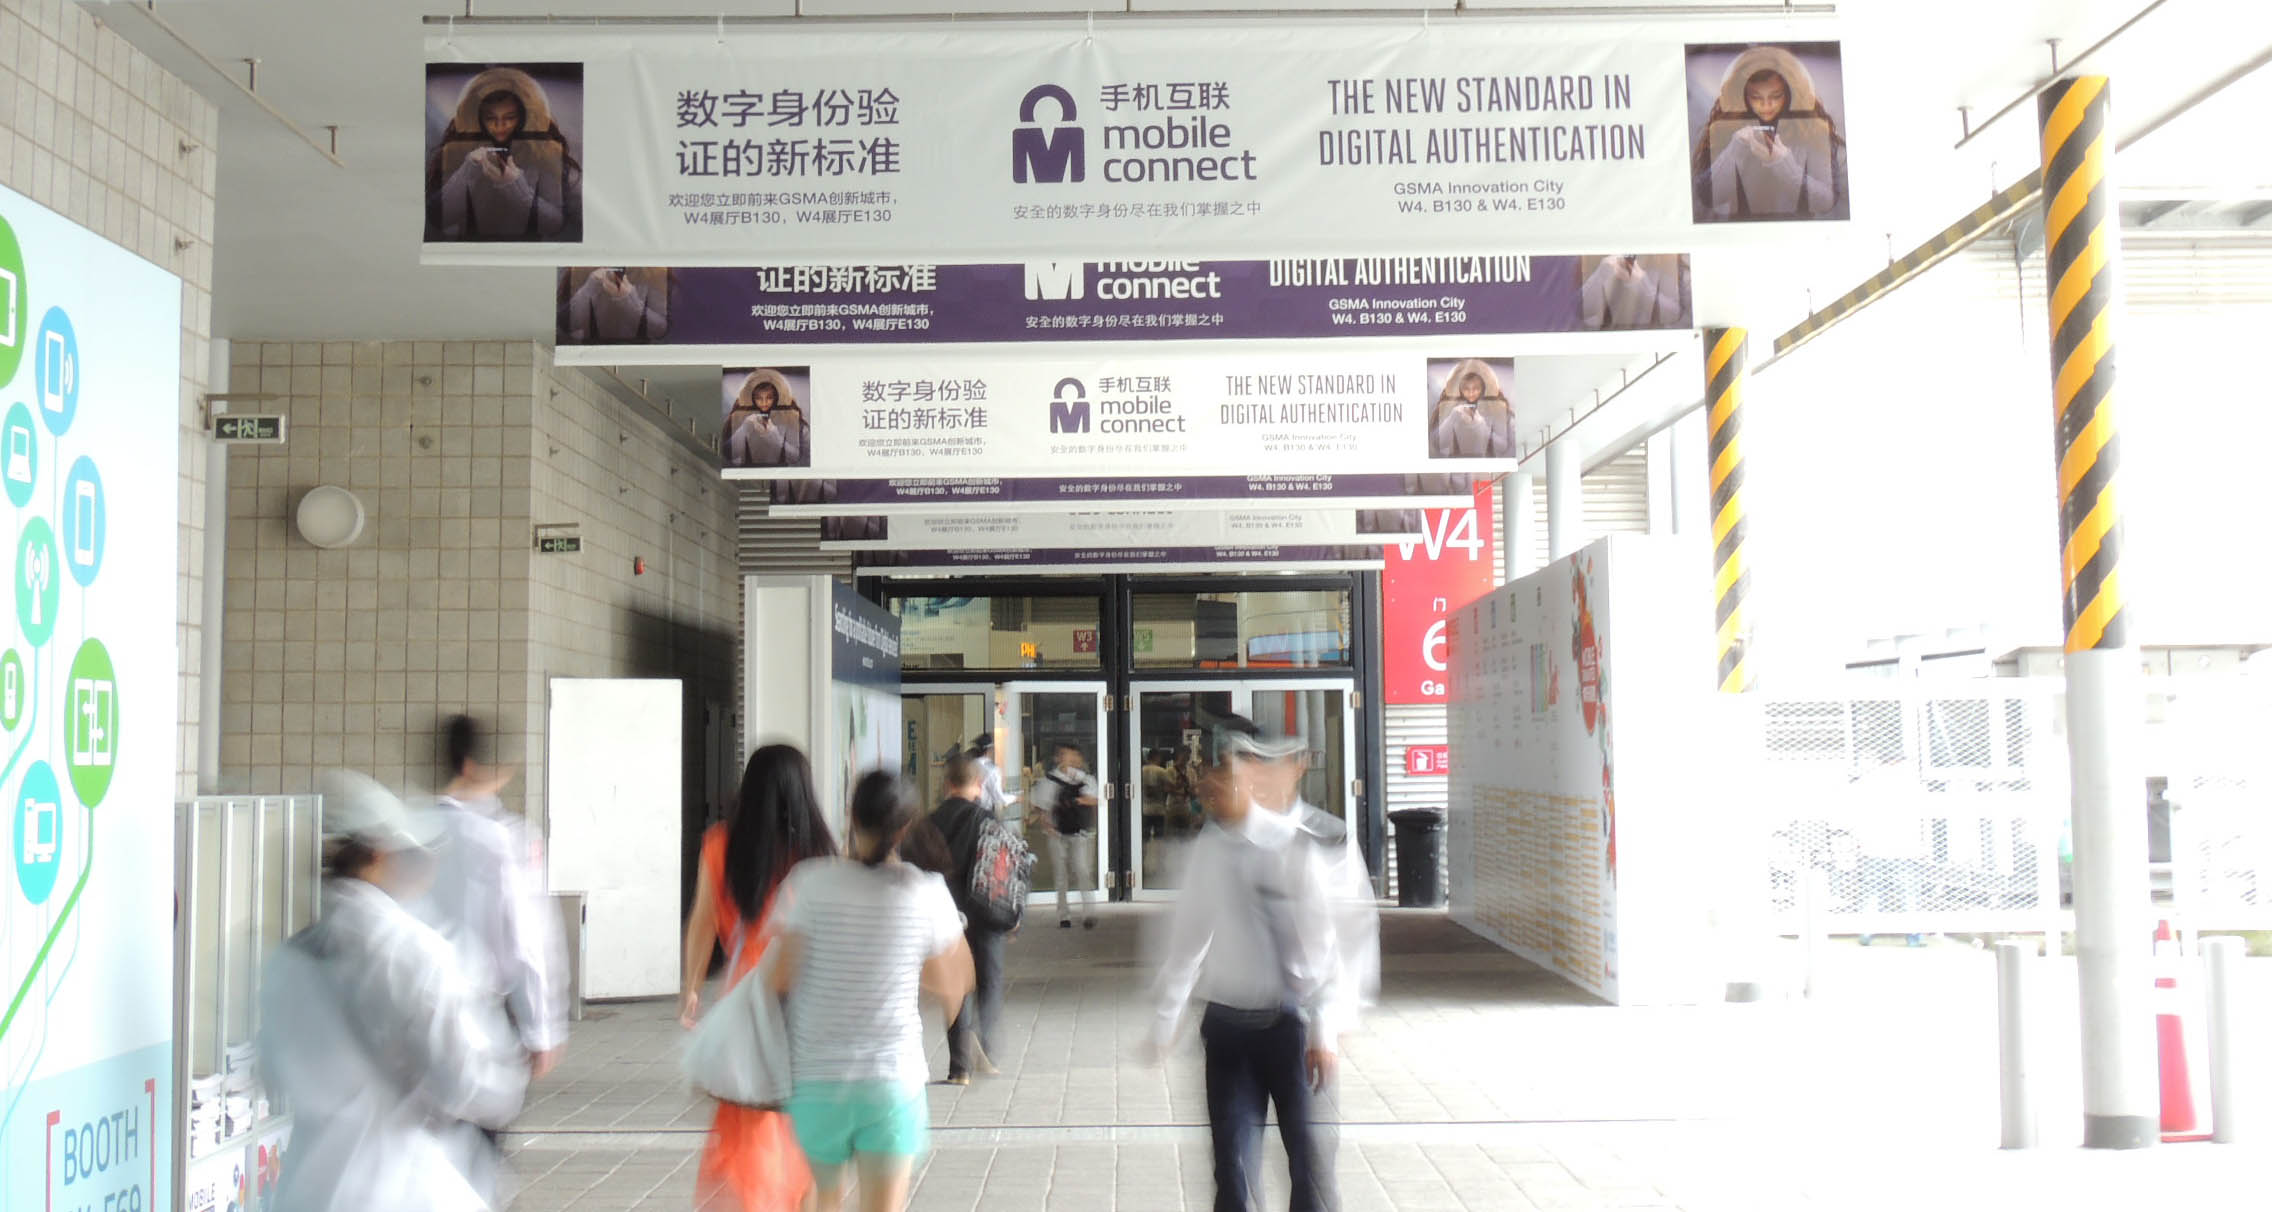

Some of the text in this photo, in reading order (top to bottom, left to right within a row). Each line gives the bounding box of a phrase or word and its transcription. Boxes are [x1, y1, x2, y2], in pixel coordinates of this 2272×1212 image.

[1100, 81, 1230, 111] 手机互联
[1327, 74, 1631, 115] THE NEW STANDARD IN
[676, 88, 900, 127] 数字身份验
[1104, 116, 1231, 149] mobile
[1319, 124, 1645, 165] DIGITAL AUTHENTICATION
[676, 137, 900, 177] 证的新标准
[1104, 150, 1257, 182] connect
[1394, 179, 1564, 195] GSMA Innovation City
[1013, 200, 1262, 219] 安全的数字身份尽在我们掌握之中
[1398, 197, 1566, 213] W4. B130 & W4. E130
[757, 264, 937, 293] 证的新标准
[1269, 255, 1531, 286] DIGITAL AUTHENTICATION
[1097, 272, 1221, 299] connect
[1329, 296, 1465, 310] GSMA Innovation City
[1026, 313, 1224, 328] 安全的数字身份尽在我们掌握之中
[1360, 312, 1392, 324] B130
[1395, 312, 1404, 323] &
[1435, 311, 1466, 323] E130
[862, 379, 987, 402] 数字身份验
[1099, 376, 1171, 393] 手机互联
[1225, 373, 1396, 396] THE NEW STANDARD IN
[1100, 395, 1171, 415] mobile
[1220, 402, 1403, 424] DIGITAL AUTHENTICATION
[862, 407, 988, 430] 证的新标准
[1100, 415, 1186, 433] connect
[1399, 509, 1485, 561] W4
[1077, 631, 1092, 641] W3
[1421, 680, 1446, 695] Ga
[64, 1105, 138, 1186] BOOTH
